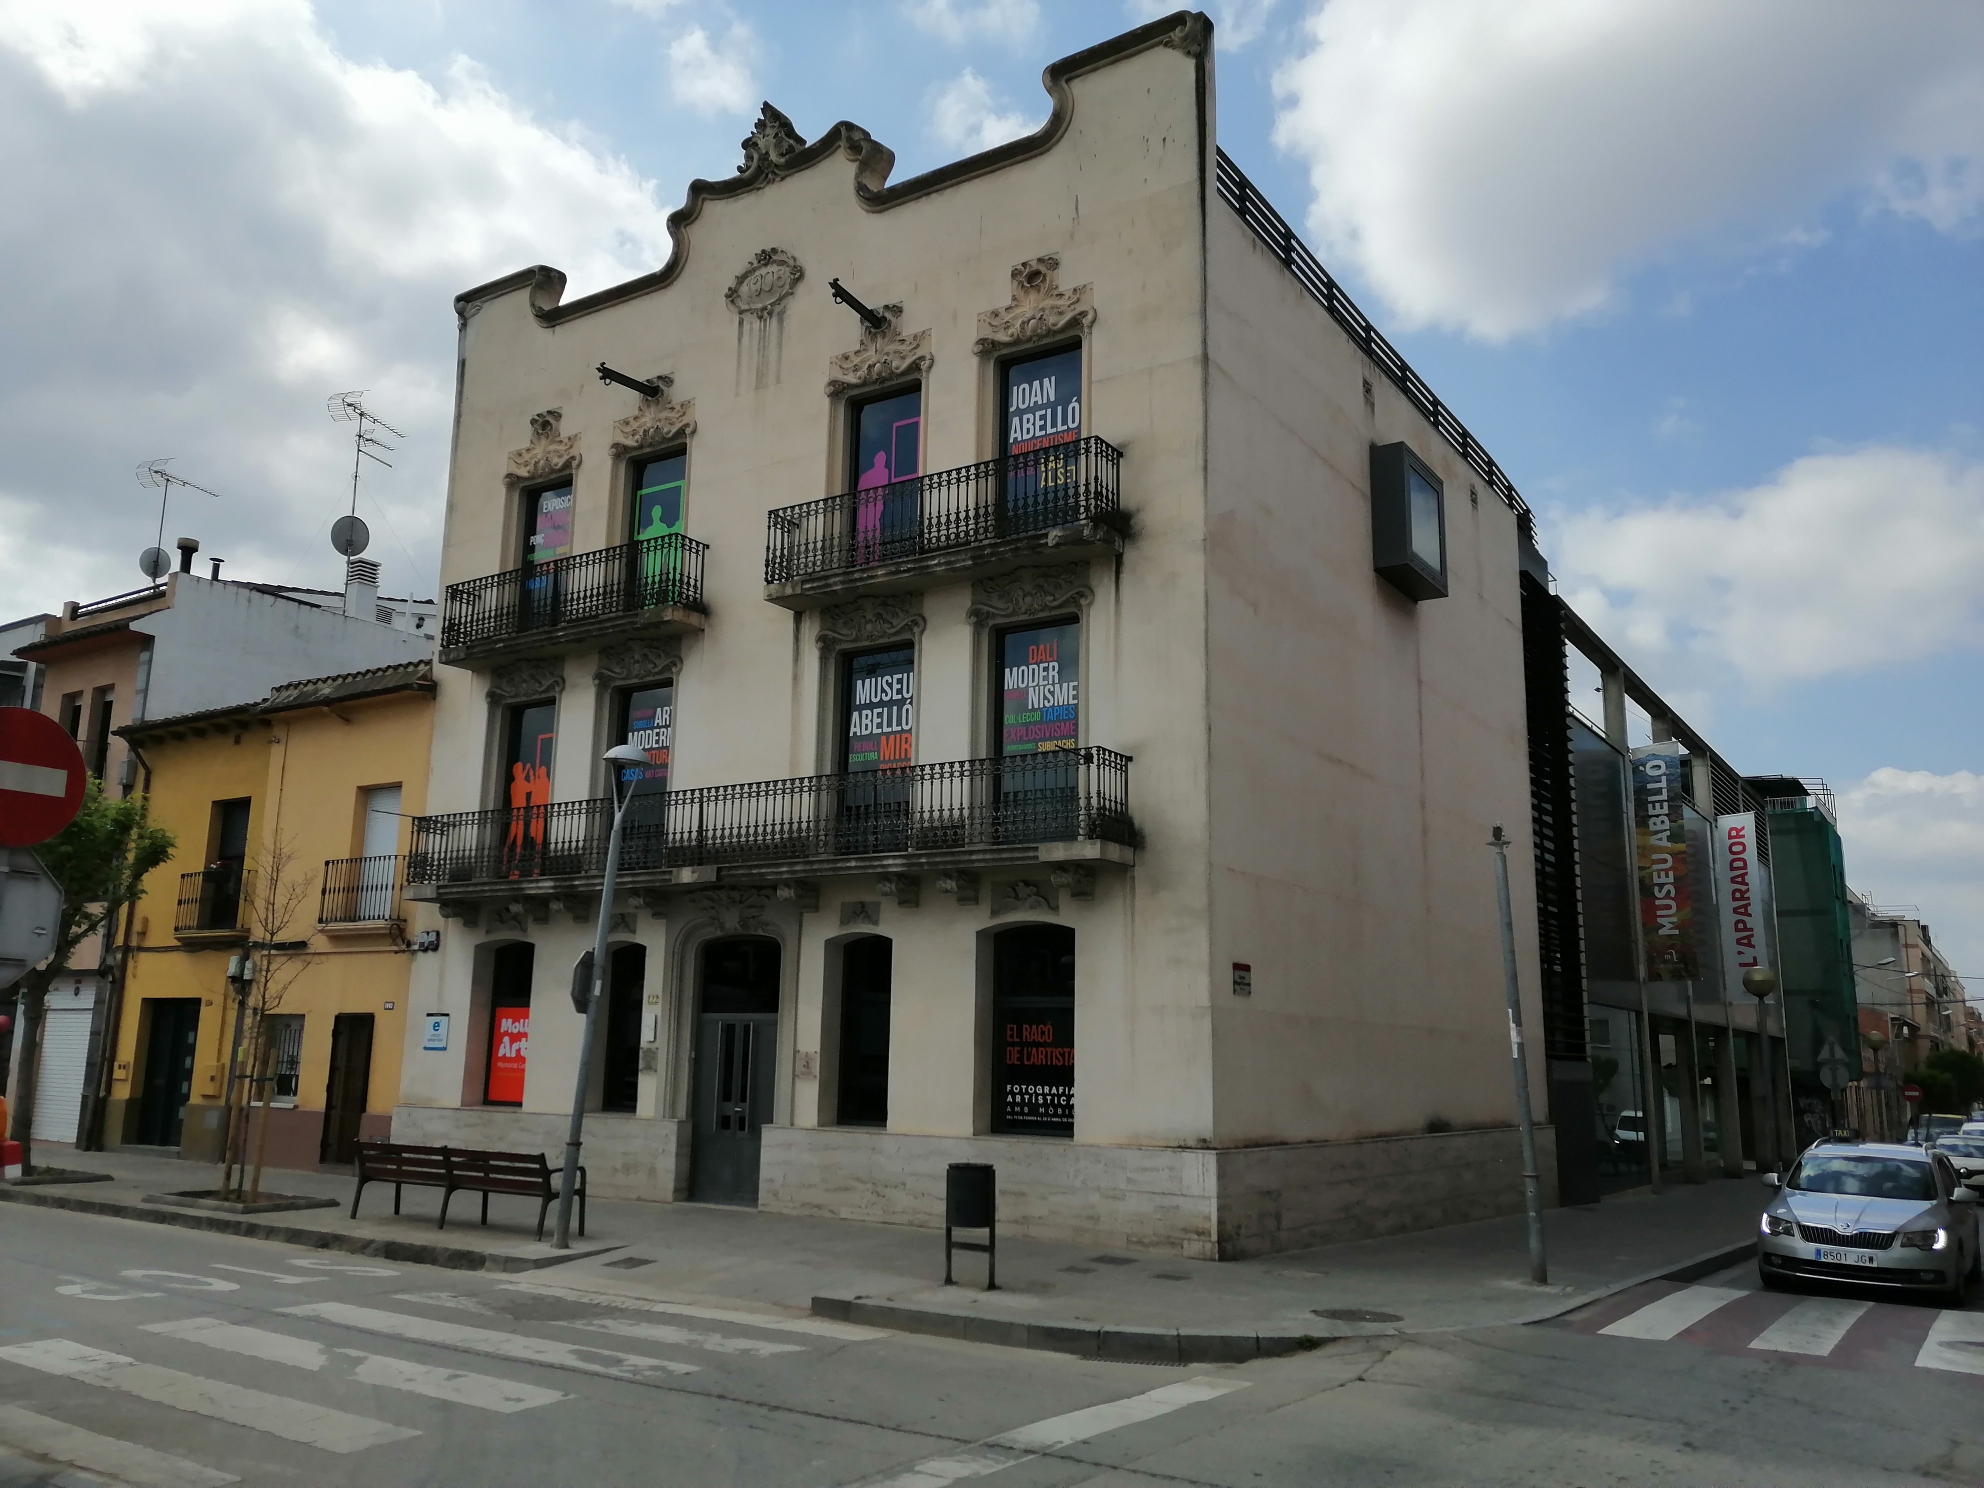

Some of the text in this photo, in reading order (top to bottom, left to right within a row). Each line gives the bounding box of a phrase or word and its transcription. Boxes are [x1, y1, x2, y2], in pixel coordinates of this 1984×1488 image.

[1009, 376, 1056, 413] JOAN
[1009, 397, 1080, 444] ABELLÓ
[1028, 639, 1058, 664] DALÍ
[1004, 662, 1059, 690] MODER
[856, 672, 914, 706] MUSEU
[1028, 682, 1079, 710] NISME
[655, 706, 673, 726] AR
[849, 699, 913, 737] ABELLÓ
[1004, 720, 1077, 744] EXPLOSIVISME
[1639, 758, 1672, 848] ABELLÓ
[1650, 853, 1680, 936] MUSEU
[1727, 825, 1759, 968] L'APARADOR
[1006, 1021, 1053, 1043] EL RACÓ
[1006, 1046, 1021, 1065] DE
[1006, 1084, 1075, 1095] FOTOGRAFIA
[1006, 1094, 1075, 1105] ARTÍSTICA
[1006, 1105, 1029, 1113] AMB
[1834, 1129, 1850, 1137] TAXI
[1822, 1250, 1848, 1262] 8501
